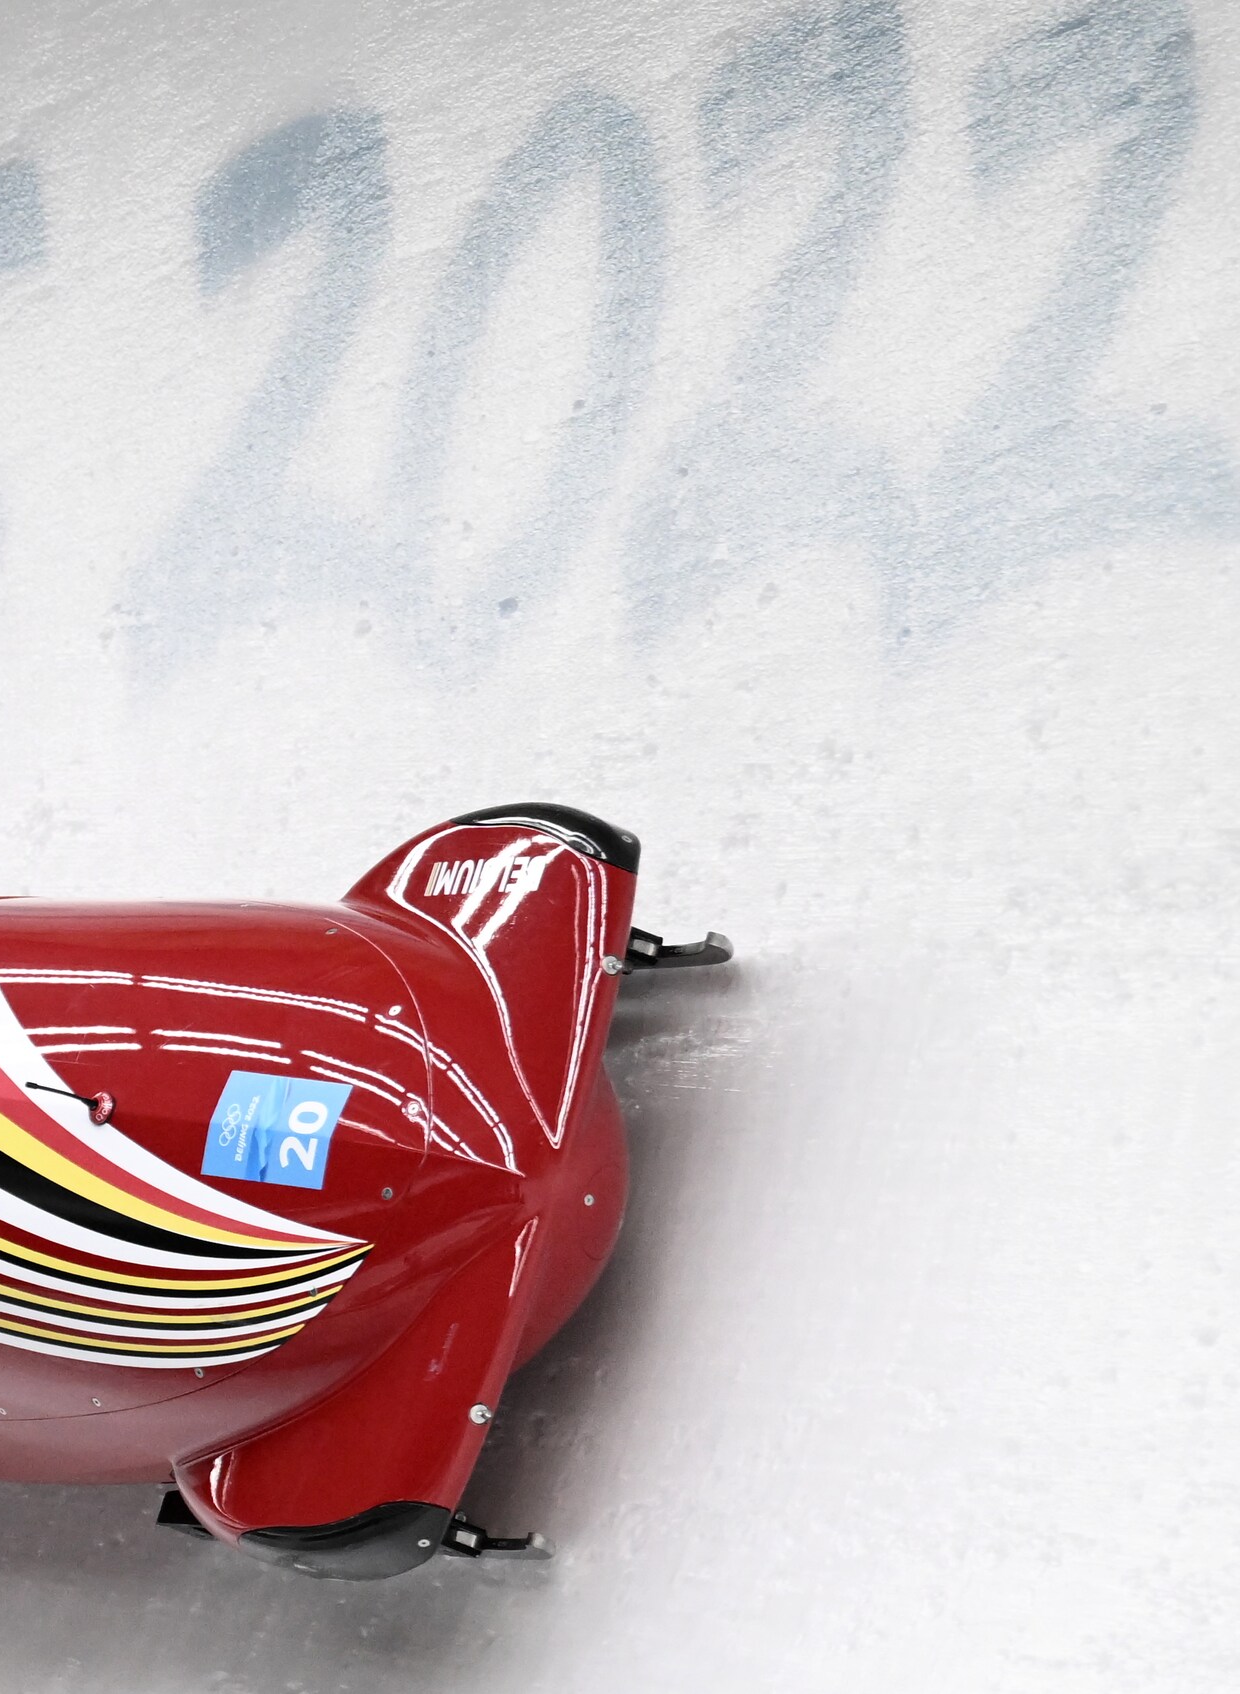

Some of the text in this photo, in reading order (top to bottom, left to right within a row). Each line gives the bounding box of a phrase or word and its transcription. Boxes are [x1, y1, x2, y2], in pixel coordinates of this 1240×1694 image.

[115, 0, 1240, 695] 2022
[234, 1095, 261, 1162] BEIJING 2022
[279, 1100, 328, 1171] 20
